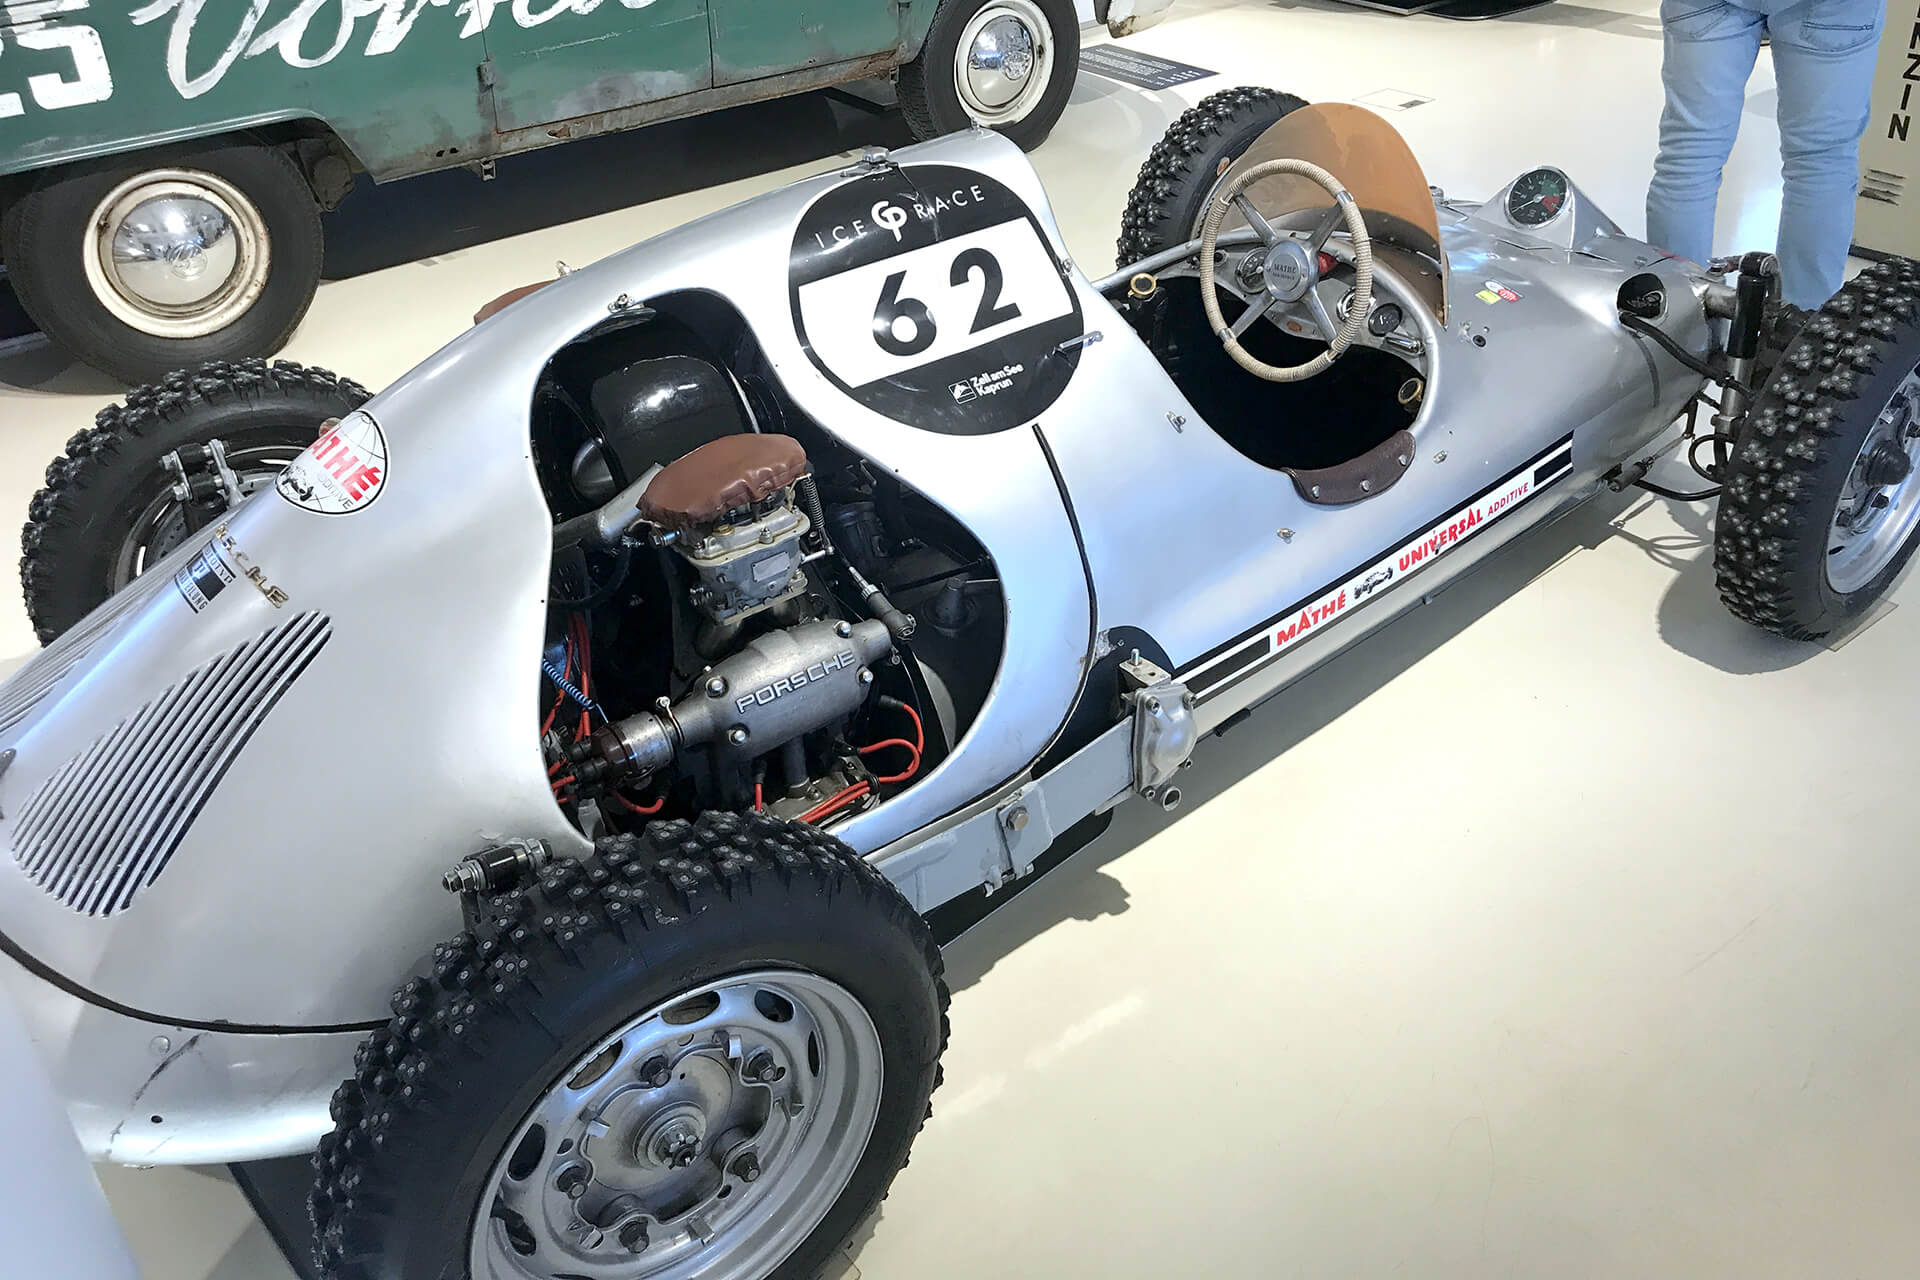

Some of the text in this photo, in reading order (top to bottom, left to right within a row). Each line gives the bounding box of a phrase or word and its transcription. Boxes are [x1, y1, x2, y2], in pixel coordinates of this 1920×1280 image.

[815, 219, 867, 249] ICE
[913, 185, 985, 220] RACE
[872, 247, 1022, 357] 62
[969, 364, 1024, 388] Zell am See
[976, 378, 1014, 396] Kaprun
[1276, 481, 1529, 647] MATHÉ UNIVERSAL ADDITIVE
[735, 649, 856, 714] PORSCHE
